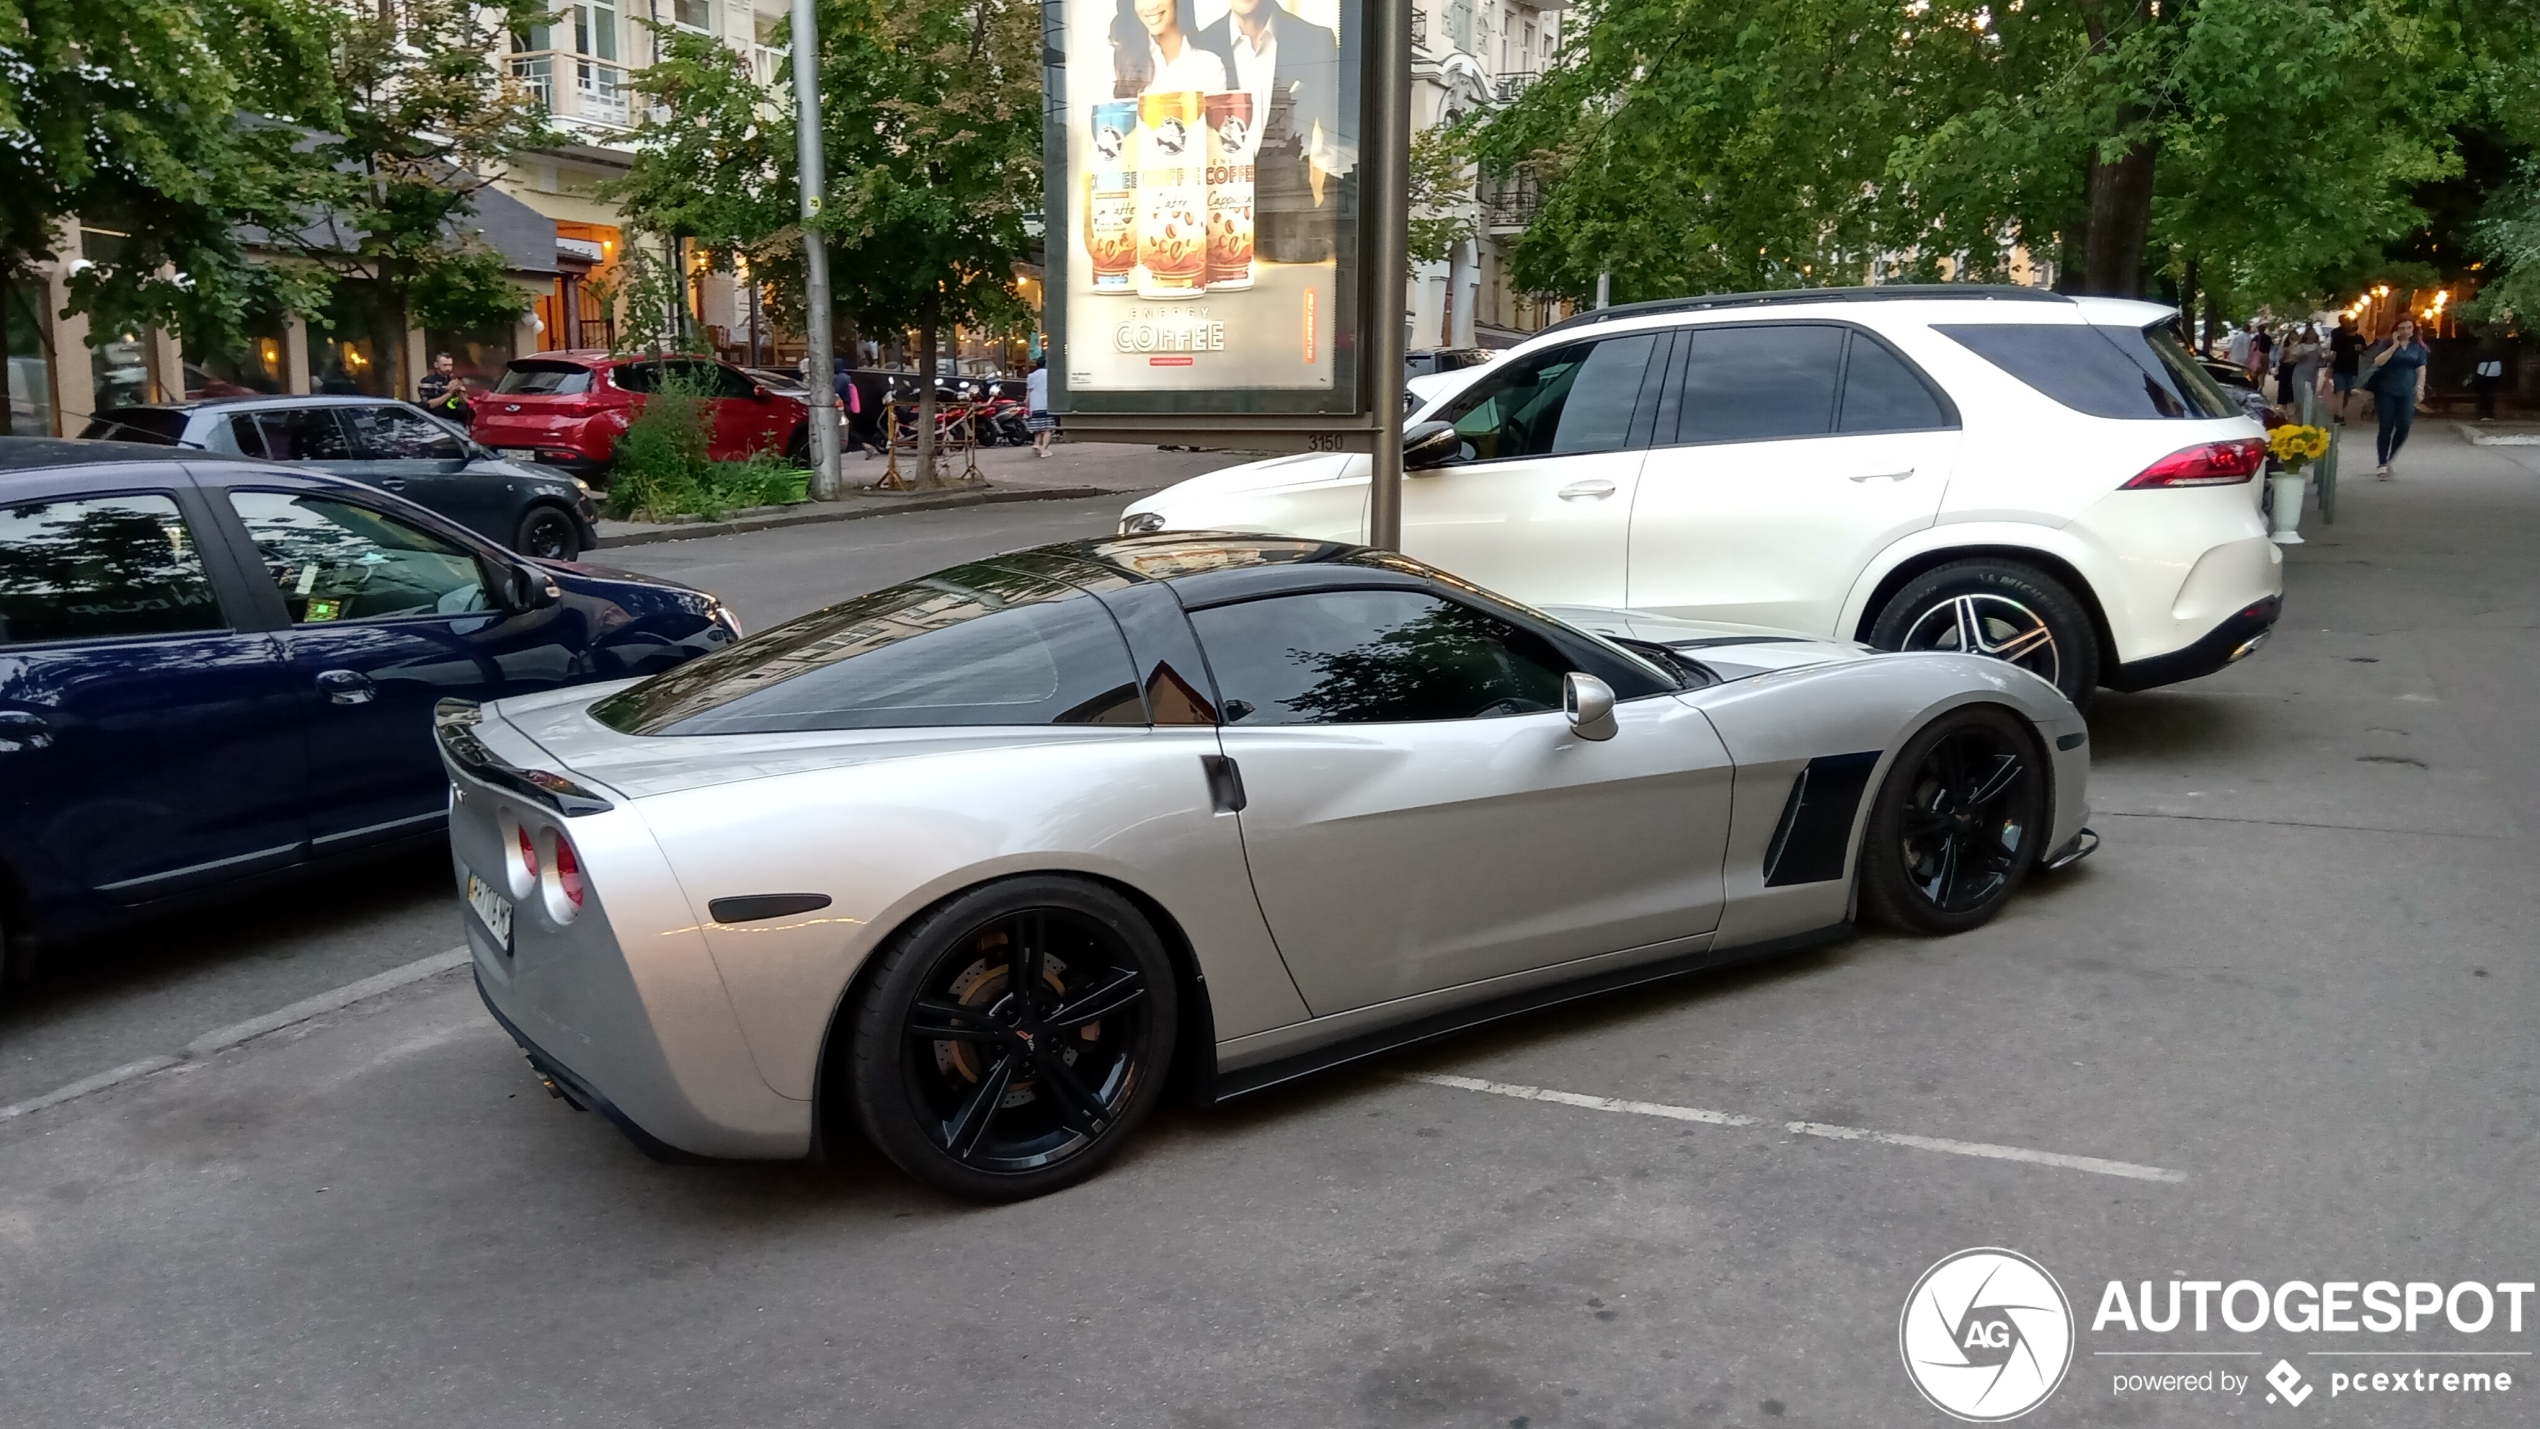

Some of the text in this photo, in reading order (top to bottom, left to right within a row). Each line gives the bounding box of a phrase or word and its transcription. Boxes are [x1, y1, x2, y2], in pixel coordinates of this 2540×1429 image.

[1130, 307, 1209, 320] ENERGY
[1113, 320, 1224, 353] COFFEE
[1309, 434, 1343, 451] 3150
